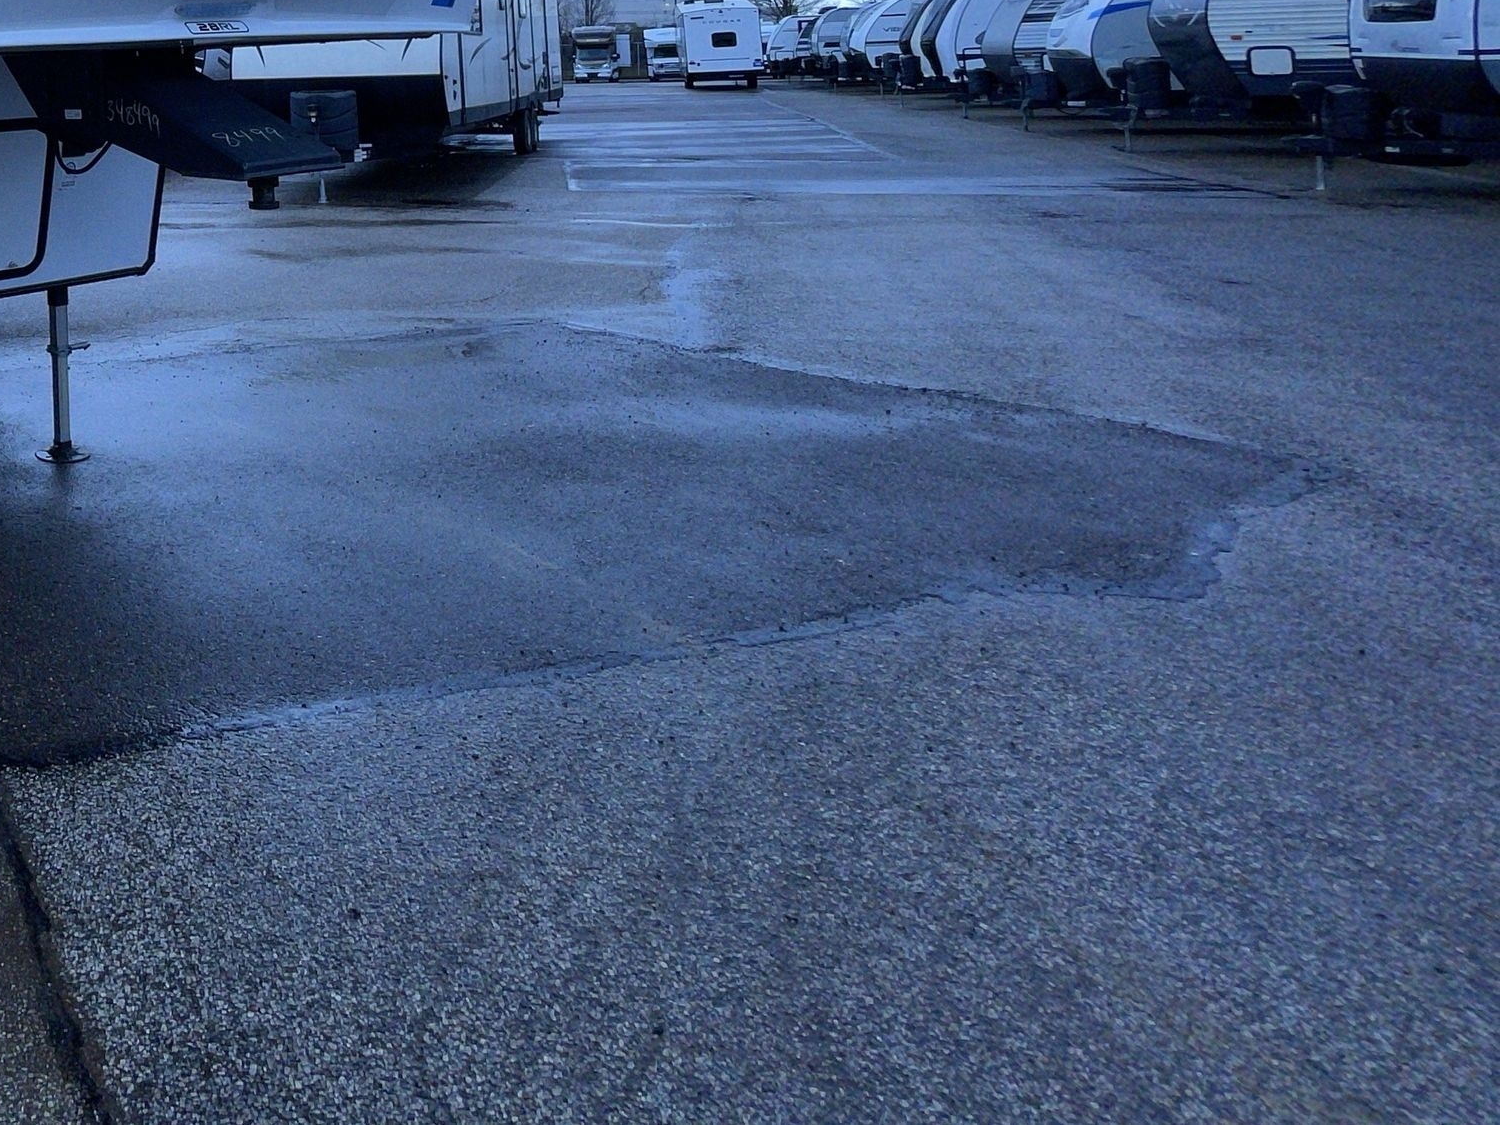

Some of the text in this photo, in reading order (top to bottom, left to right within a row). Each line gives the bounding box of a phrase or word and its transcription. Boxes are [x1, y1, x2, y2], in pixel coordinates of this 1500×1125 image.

[196, 22, 240, 32] 28RL
[106, 98, 161, 139] 348499
[211, 126, 284, 148] 8499
